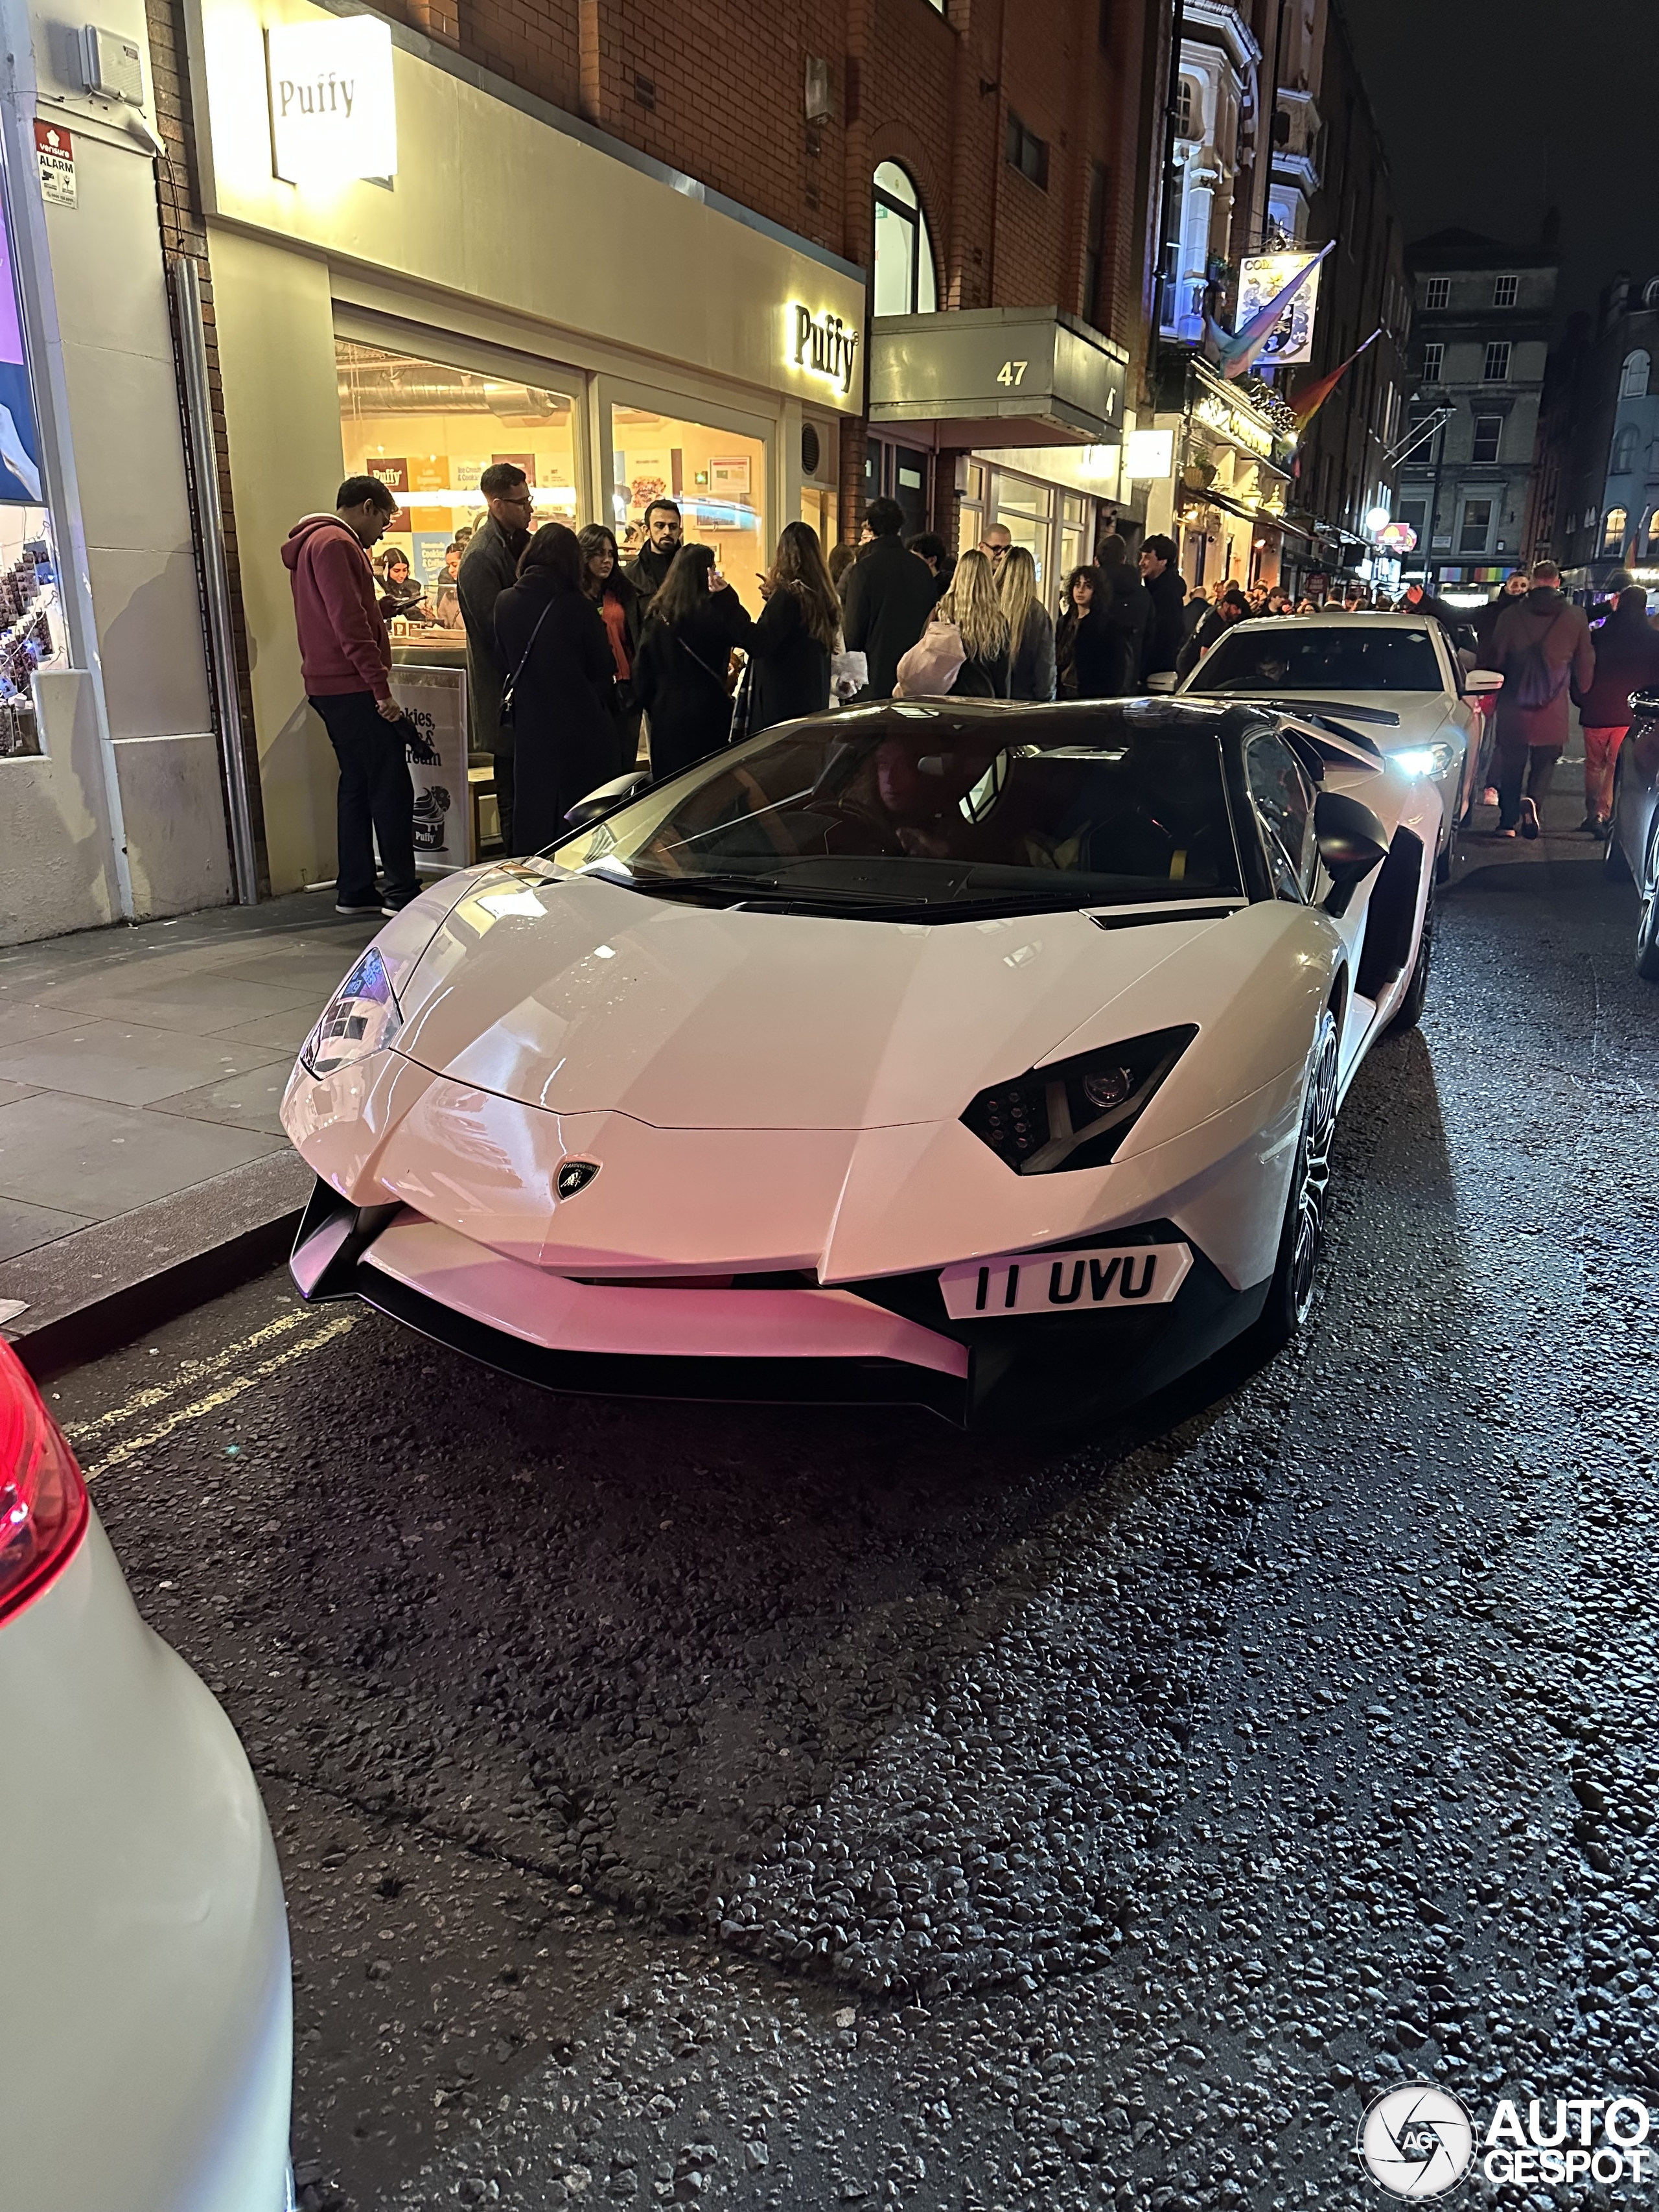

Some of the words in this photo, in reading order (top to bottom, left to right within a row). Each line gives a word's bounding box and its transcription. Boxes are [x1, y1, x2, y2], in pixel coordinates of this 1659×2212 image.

[279, 72, 354, 118] Puffy
[40, 143, 70, 158] verisure
[40, 155, 74, 173] ALARM
[997, 361, 1028, 386] 47
[373, 469, 402, 485] Puffy
[415, 831, 436, 844] Puffy
[1048, 1254, 1157, 1304] UVU
